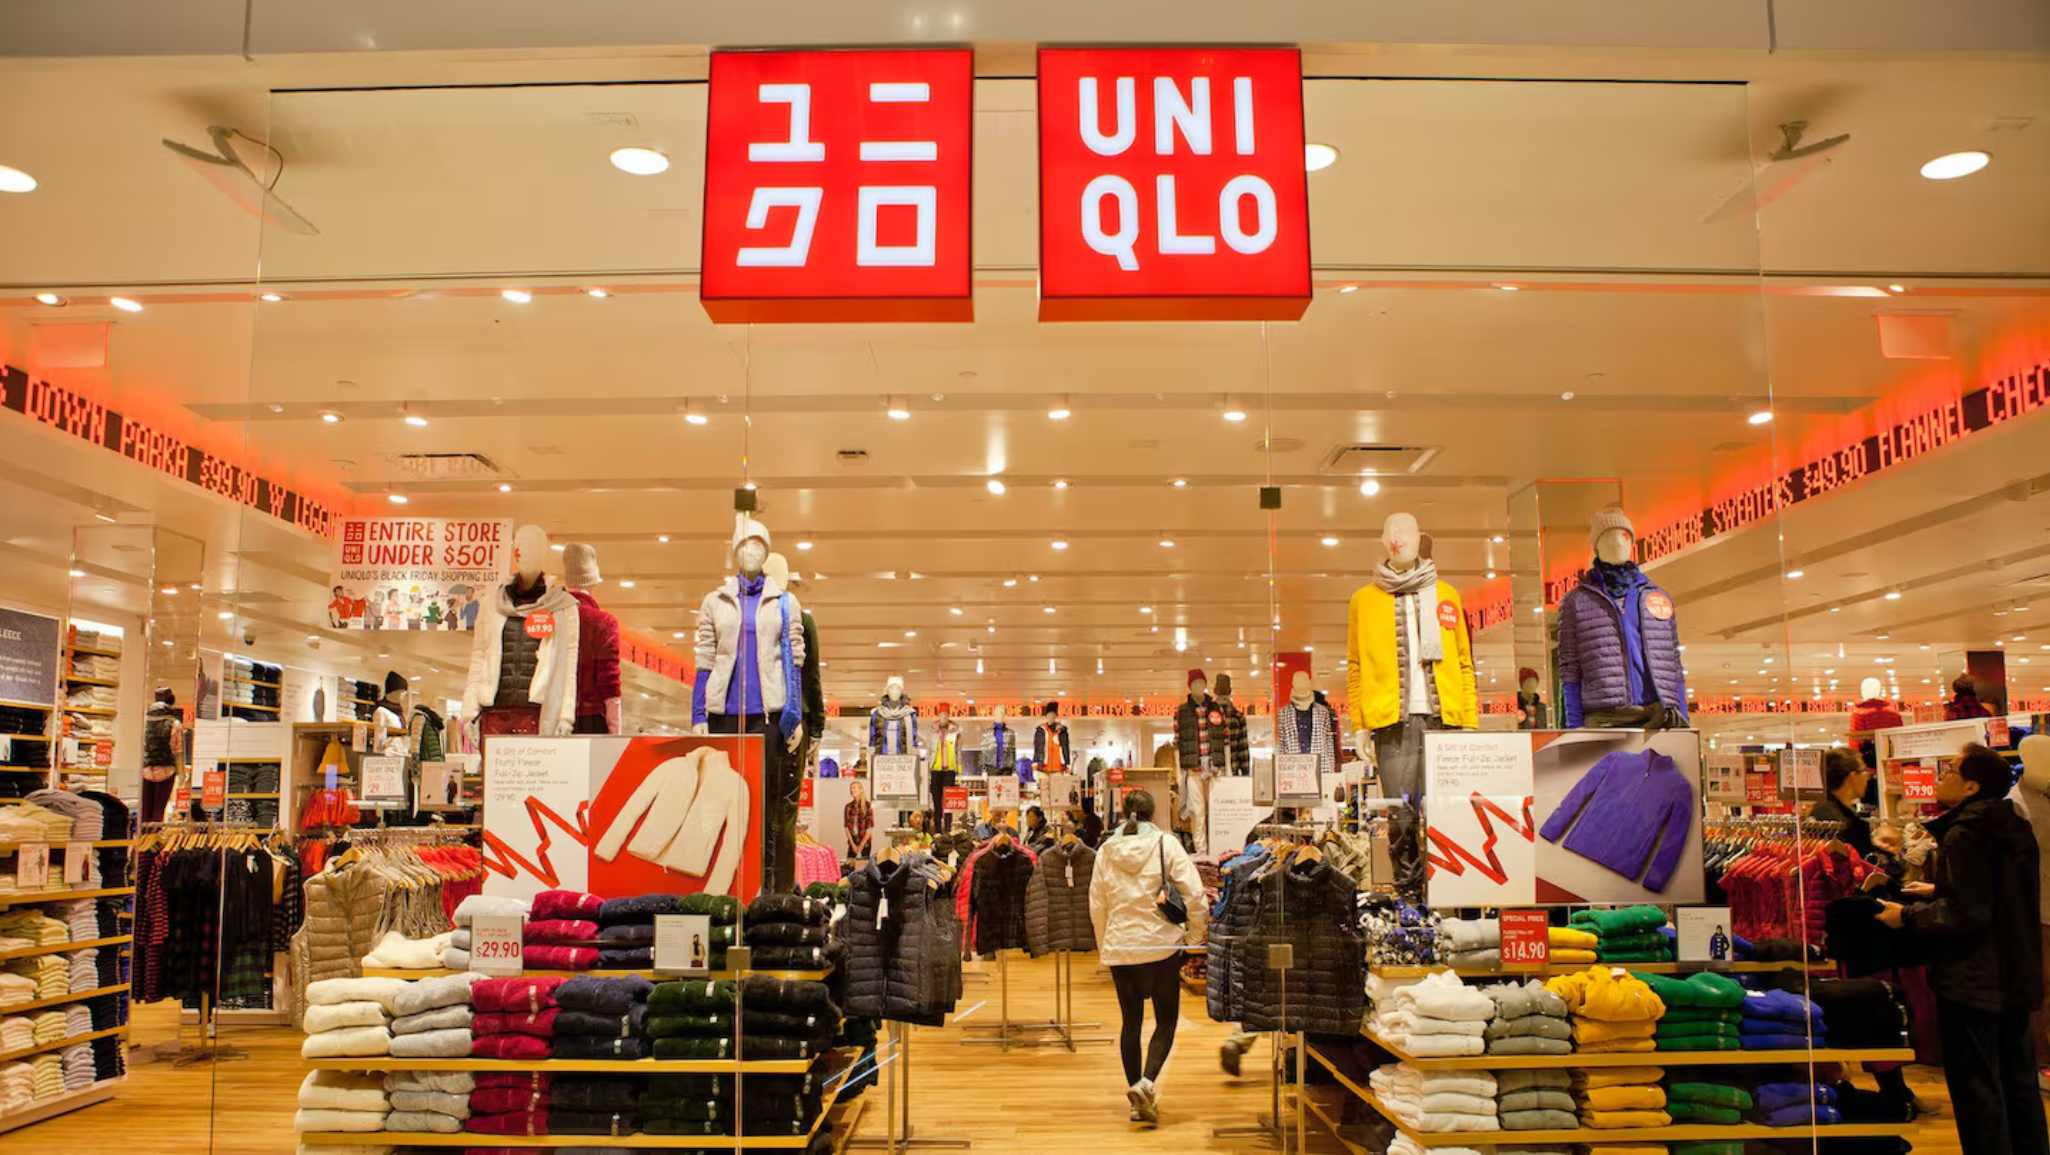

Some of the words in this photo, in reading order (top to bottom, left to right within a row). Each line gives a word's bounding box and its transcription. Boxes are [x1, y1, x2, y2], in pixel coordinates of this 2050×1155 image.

[748, 82, 938, 162] ユニ
[1078, 76, 1256, 156] UNI
[736, 185, 938, 268] クロ
[1080, 174, 1279, 271] QLO
[25, 374, 104, 445] DOWN
[120, 416, 190, 482] PARKA
[199, 451, 259, 506] $99.90
[1644, 513, 1704, 561] CASHMERE
[1711, 475, 1793, 535] SWEATERS
[1878, 400, 1972, 470] FLANNEL
[367, 545, 434, 566] UNDER
[444, 521, 501, 542] STORE
[380, 570, 407, 581] BLACK
[410, 571, 439, 581] FRIDAY
[440, 571, 481, 582] SHOPPING
[483, 571, 500, 582] LIST
[476, 941, 519, 958] $29.90
[1503, 941, 1546, 960] $14.90
